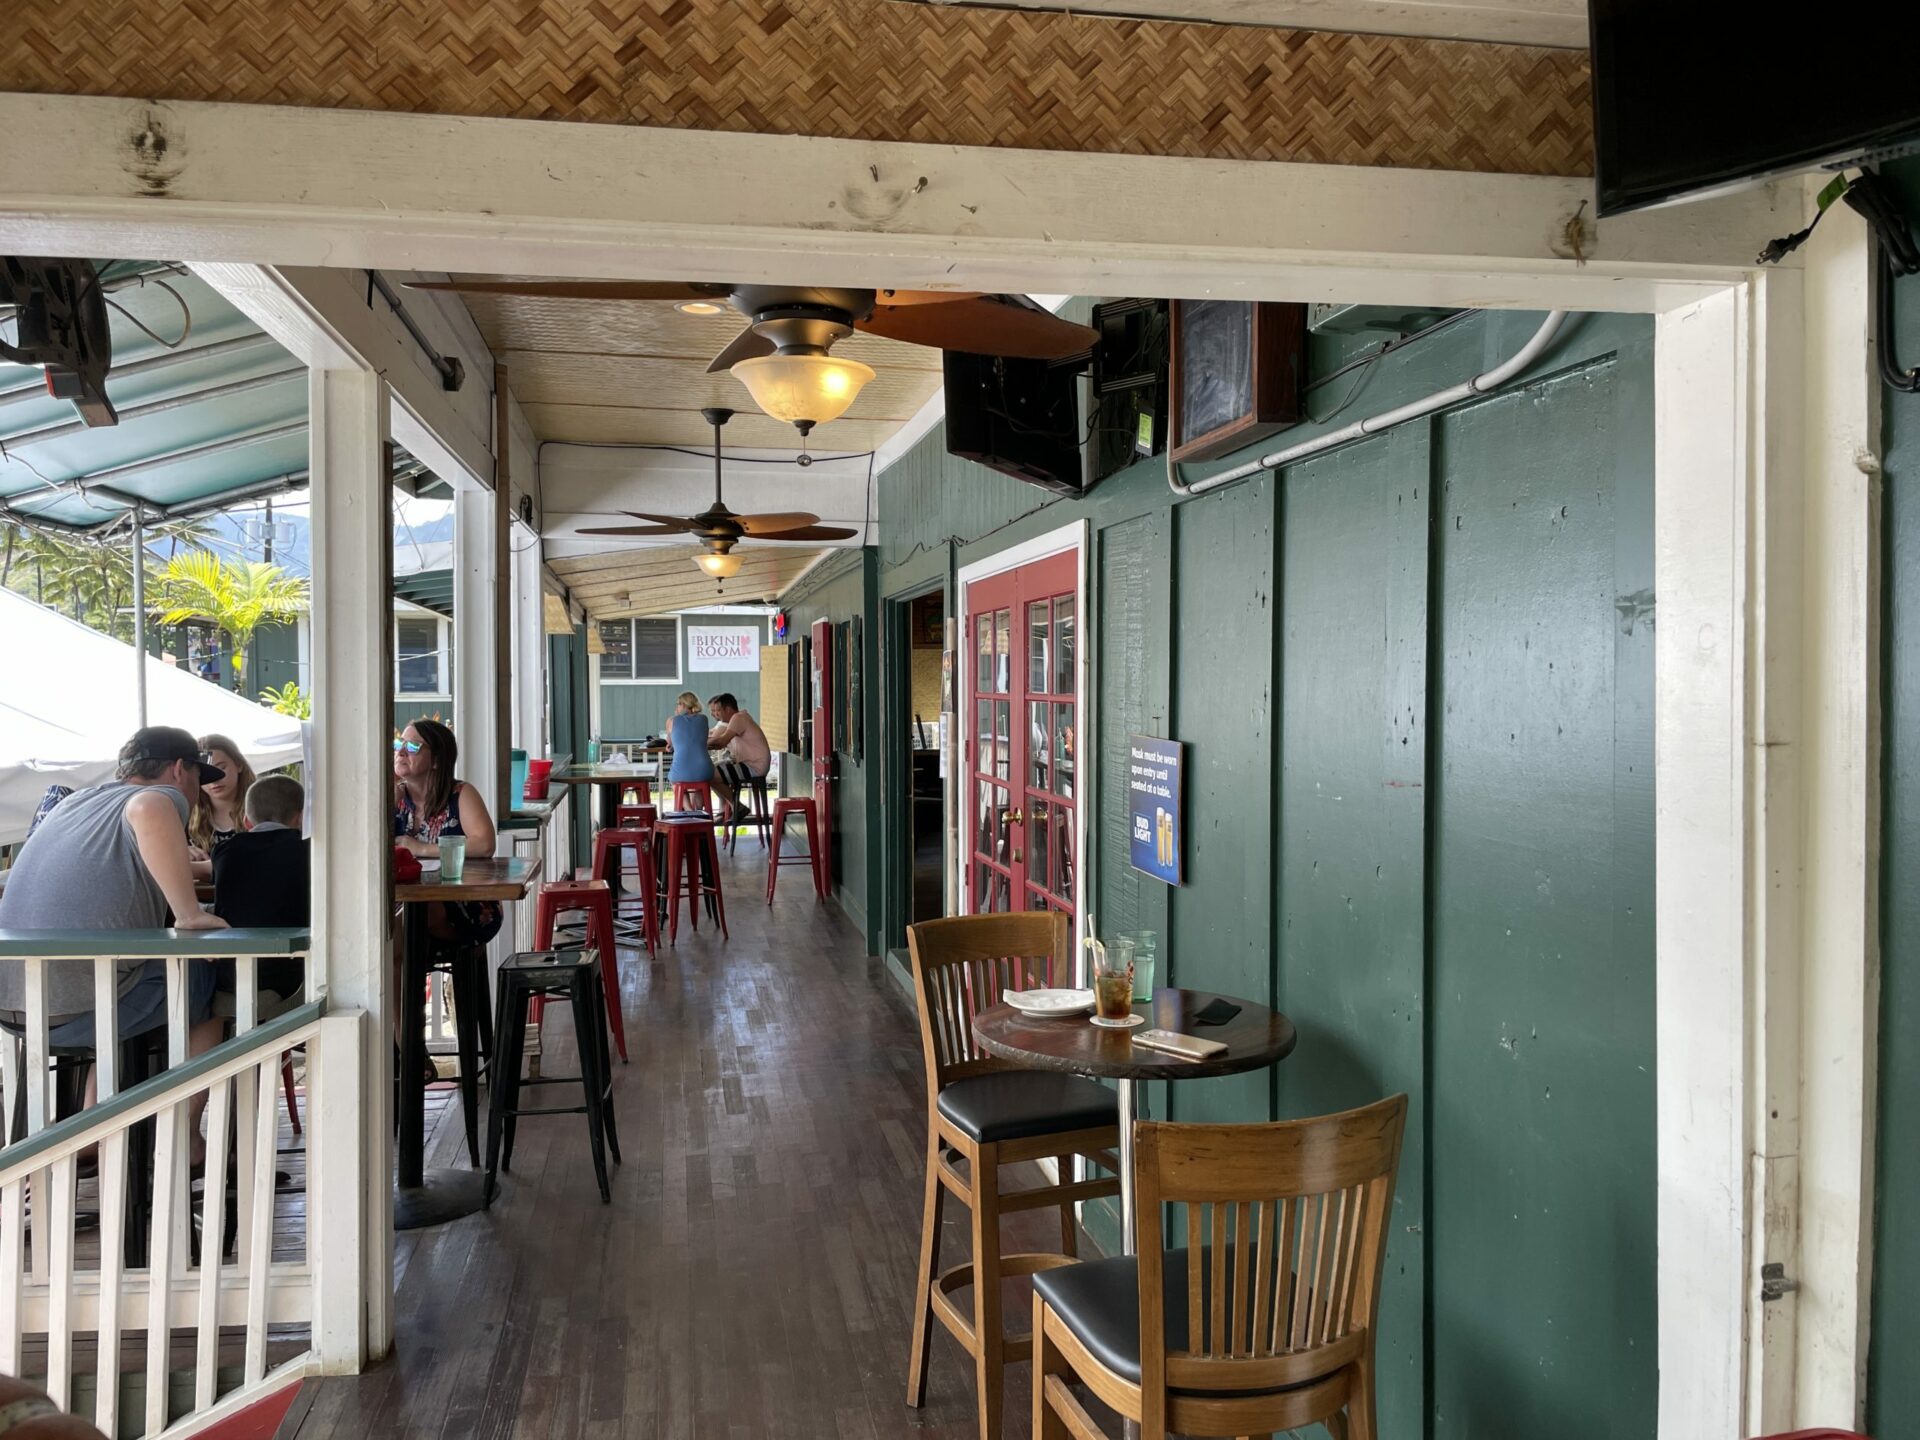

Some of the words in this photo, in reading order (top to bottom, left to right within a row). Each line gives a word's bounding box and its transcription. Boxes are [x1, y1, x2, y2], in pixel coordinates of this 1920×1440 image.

[696, 635, 740, 646] BIKINI
[696, 646, 741, 657] ROOM
[1131, 746, 1144, 759] Mask
[1144, 751, 1156, 762] must
[1157, 752, 1163, 763] be
[1163, 755, 1177, 766] worn
[1131, 765, 1143, 776] upon
[1143, 766, 1156, 780] entry
[1156, 769, 1168, 780] until
[1131, 780, 1146, 792] seated
[1147, 782, 1153, 793] at
[1136, 815, 1149, 829] BUD
[1134, 826, 1151, 843] LIGHT
